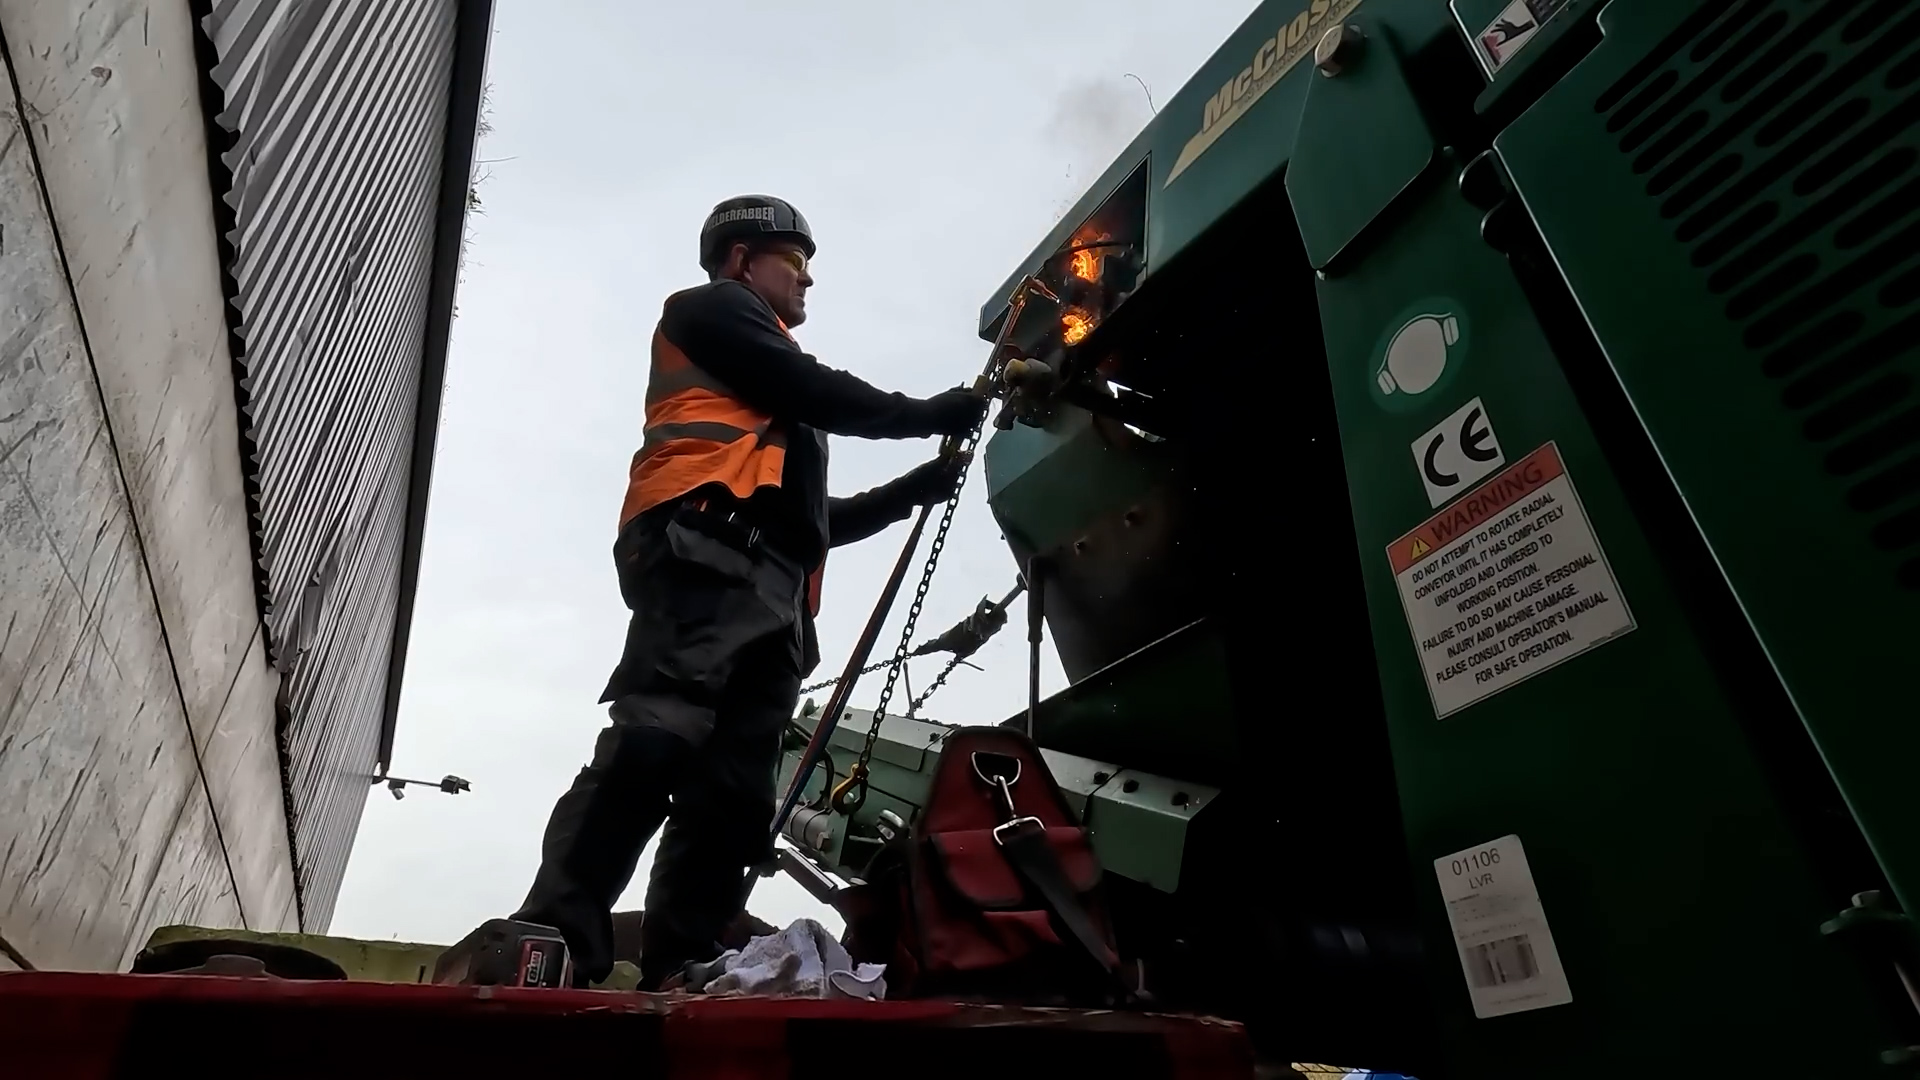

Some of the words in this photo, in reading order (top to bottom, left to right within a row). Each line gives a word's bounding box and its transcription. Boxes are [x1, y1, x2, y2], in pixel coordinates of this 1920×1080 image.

[1411, 569, 1424, 583] DO
[1423, 559, 1440, 576] NOT
[1439, 538, 1476, 567] ATTEMPT
[1475, 530, 1488, 545] TO
[1488, 510, 1521, 538] ROTATE
[1520, 490, 1555, 518] RADIAL
[1430, 459, 1544, 544] WARNING
[1413, 568, 1456, 600] CONVEYOR
[1455, 554, 1480, 576] UNTIL
[1479, 549, 1488, 562] IT
[1488, 538, 1507, 557] HAS
[1506, 504, 1565, 546] COMPLETELY
[1433, 575, 1477, 607] UNFOLDED
[1475, 565, 1495, 583] AND
[1495, 540, 1539, 573] LOWERED
[1539, 532, 1554, 548] TO
[1456, 584, 1496, 614] WORKING
[1495, 560, 1540, 592] POSITION.
[1422, 626, 1455, 651] FAILURE
[1454, 619, 1468, 634] TO
[1466, 612, 1480, 628] DO
[1479, 605, 1494, 621] SO
[1493, 595, 1513, 613] MAY
[1512, 578, 1545, 603] CAUSE
[1544, 551, 1596, 586] PERSONAL
[1435, 659, 1467, 683] PLEASE
[1467, 639, 1507, 667] CONSULT
[1564, 589, 1608, 619] MANUAL
[1446, 635, 1476, 658] INJURY
[1475, 625, 1494, 643] AND
[1494, 604, 1535, 633] MACHINE
[1534, 582, 1579, 613] DAMAGE.
[1474, 666, 1494, 684] FOR
[1493, 655, 1518, 675] SAFE
[1517, 628, 1574, 664] OPERATION.
[1452, 848, 1501, 876] 01106
[1468, 873, 1494, 889] LVR
